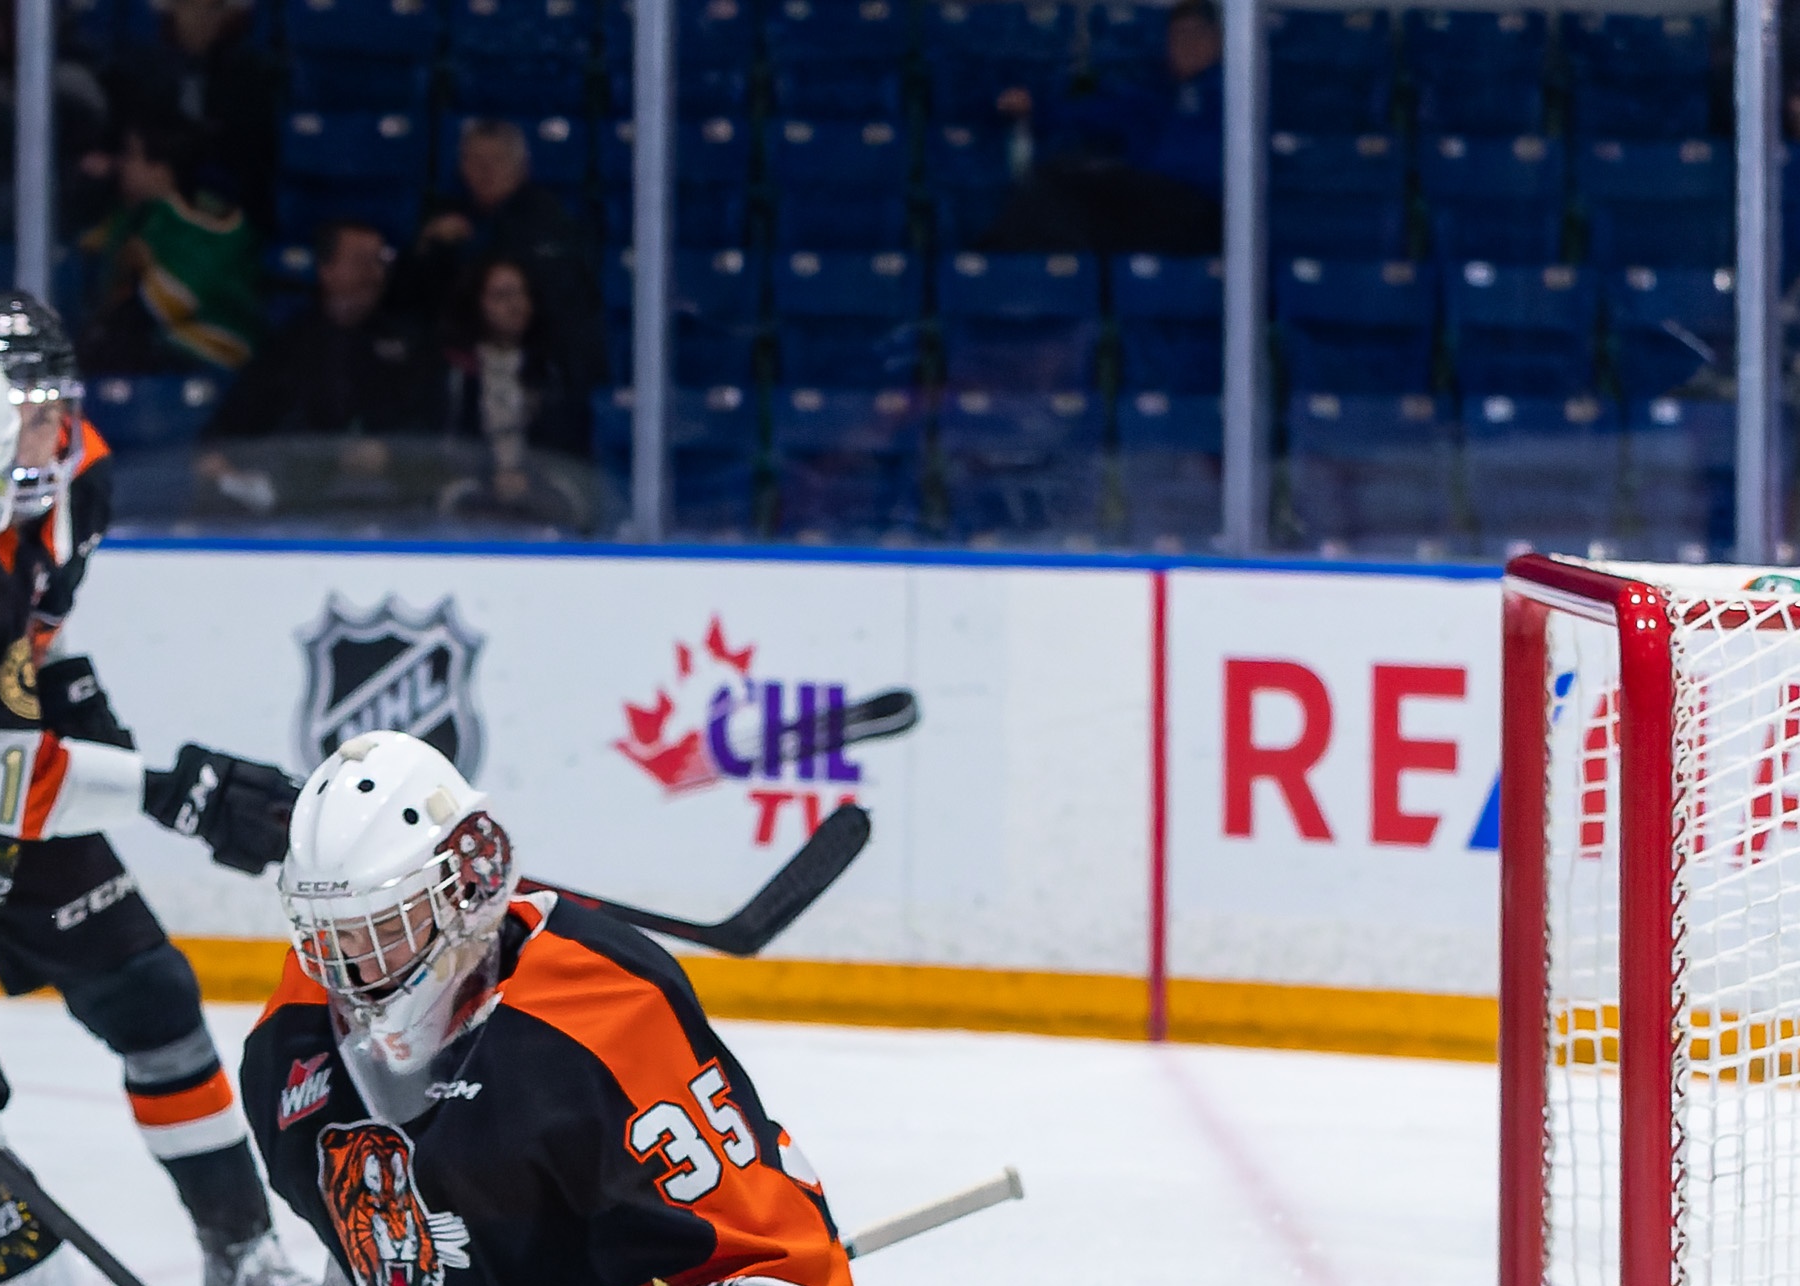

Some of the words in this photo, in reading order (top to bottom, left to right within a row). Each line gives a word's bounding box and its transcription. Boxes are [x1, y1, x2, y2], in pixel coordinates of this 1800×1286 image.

[706, 680, 861, 780] CHL
[296, 878, 350, 894] CCM
[424, 1078, 484, 1101] CCM
[627, 1060, 760, 1204] 35
